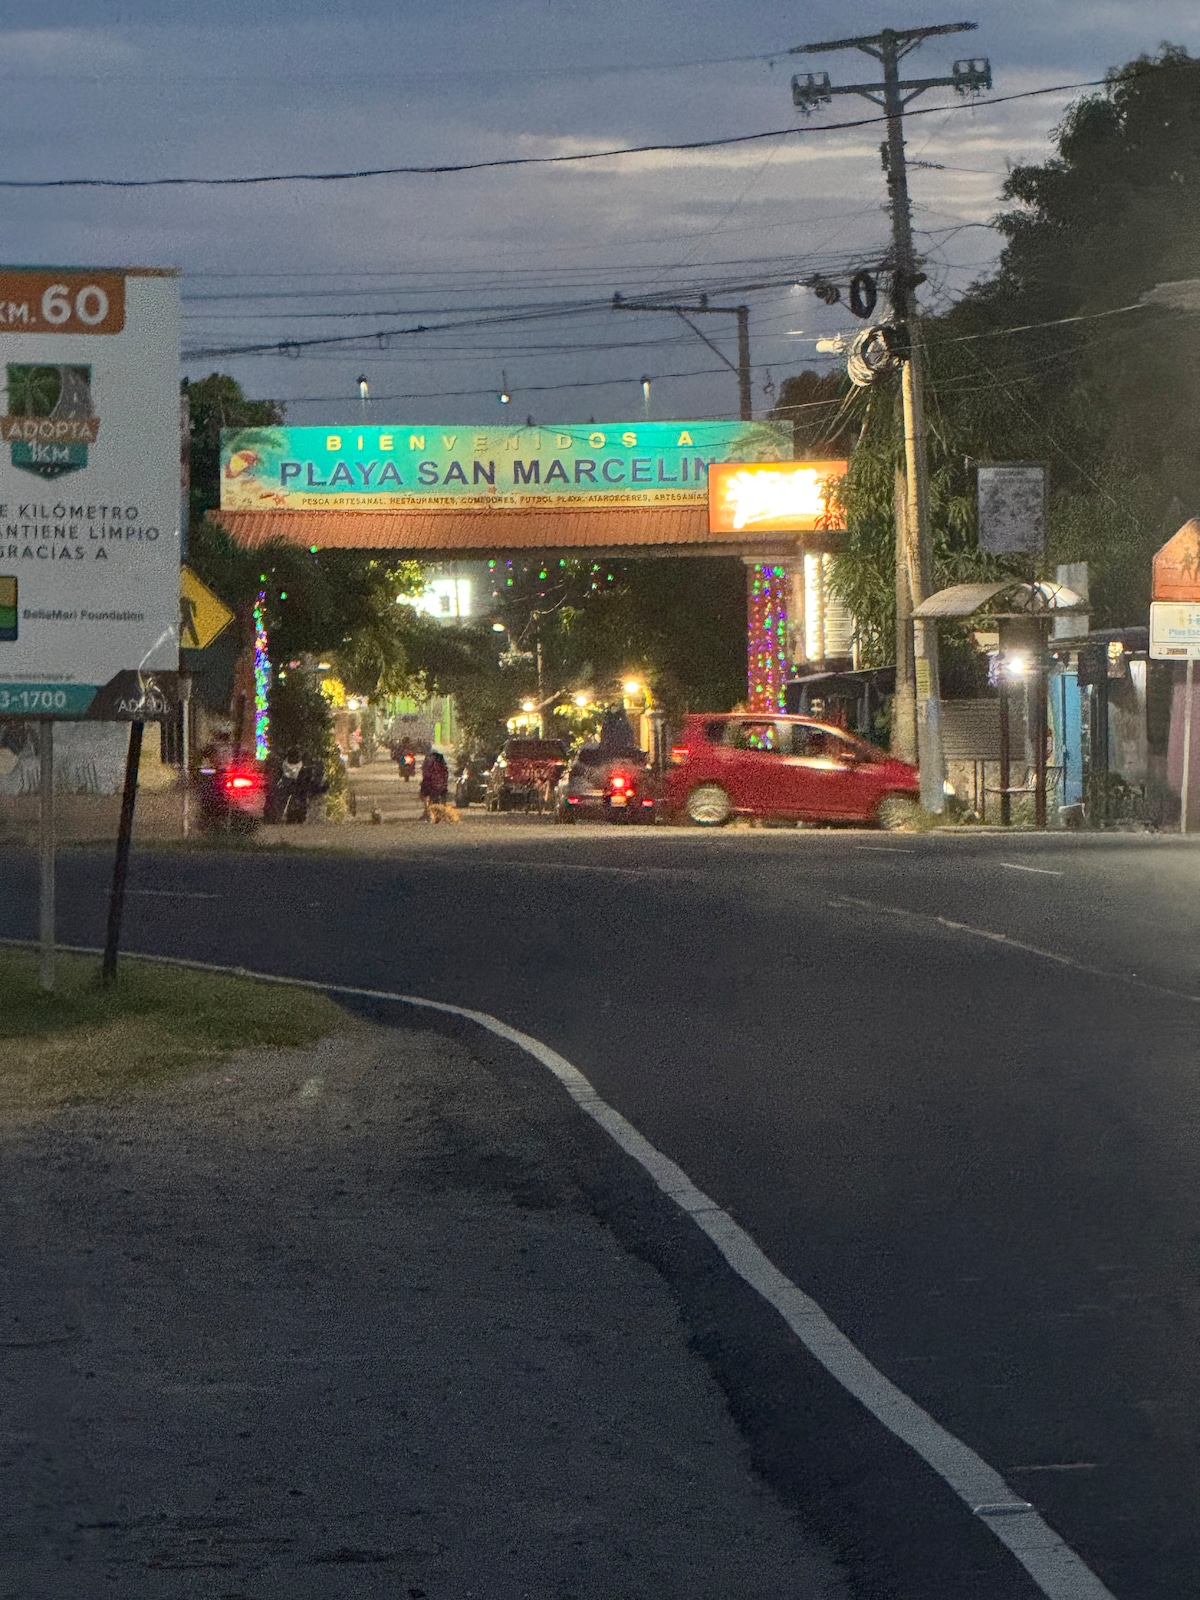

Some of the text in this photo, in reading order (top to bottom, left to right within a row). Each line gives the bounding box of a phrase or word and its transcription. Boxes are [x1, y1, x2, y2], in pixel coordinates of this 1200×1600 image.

[41, 284, 109, 326] 60
[6, 420, 92, 440] ADOPTA
[326, 431, 693, 453] BIENVENIDOS A
[280, 456, 745, 487] PLAYA SAN MARCELIN
[19, 503, 138, 520] KILÓMETRO
[95, 547, 108, 560] A
[81, 610, 144, 620] Foundation
